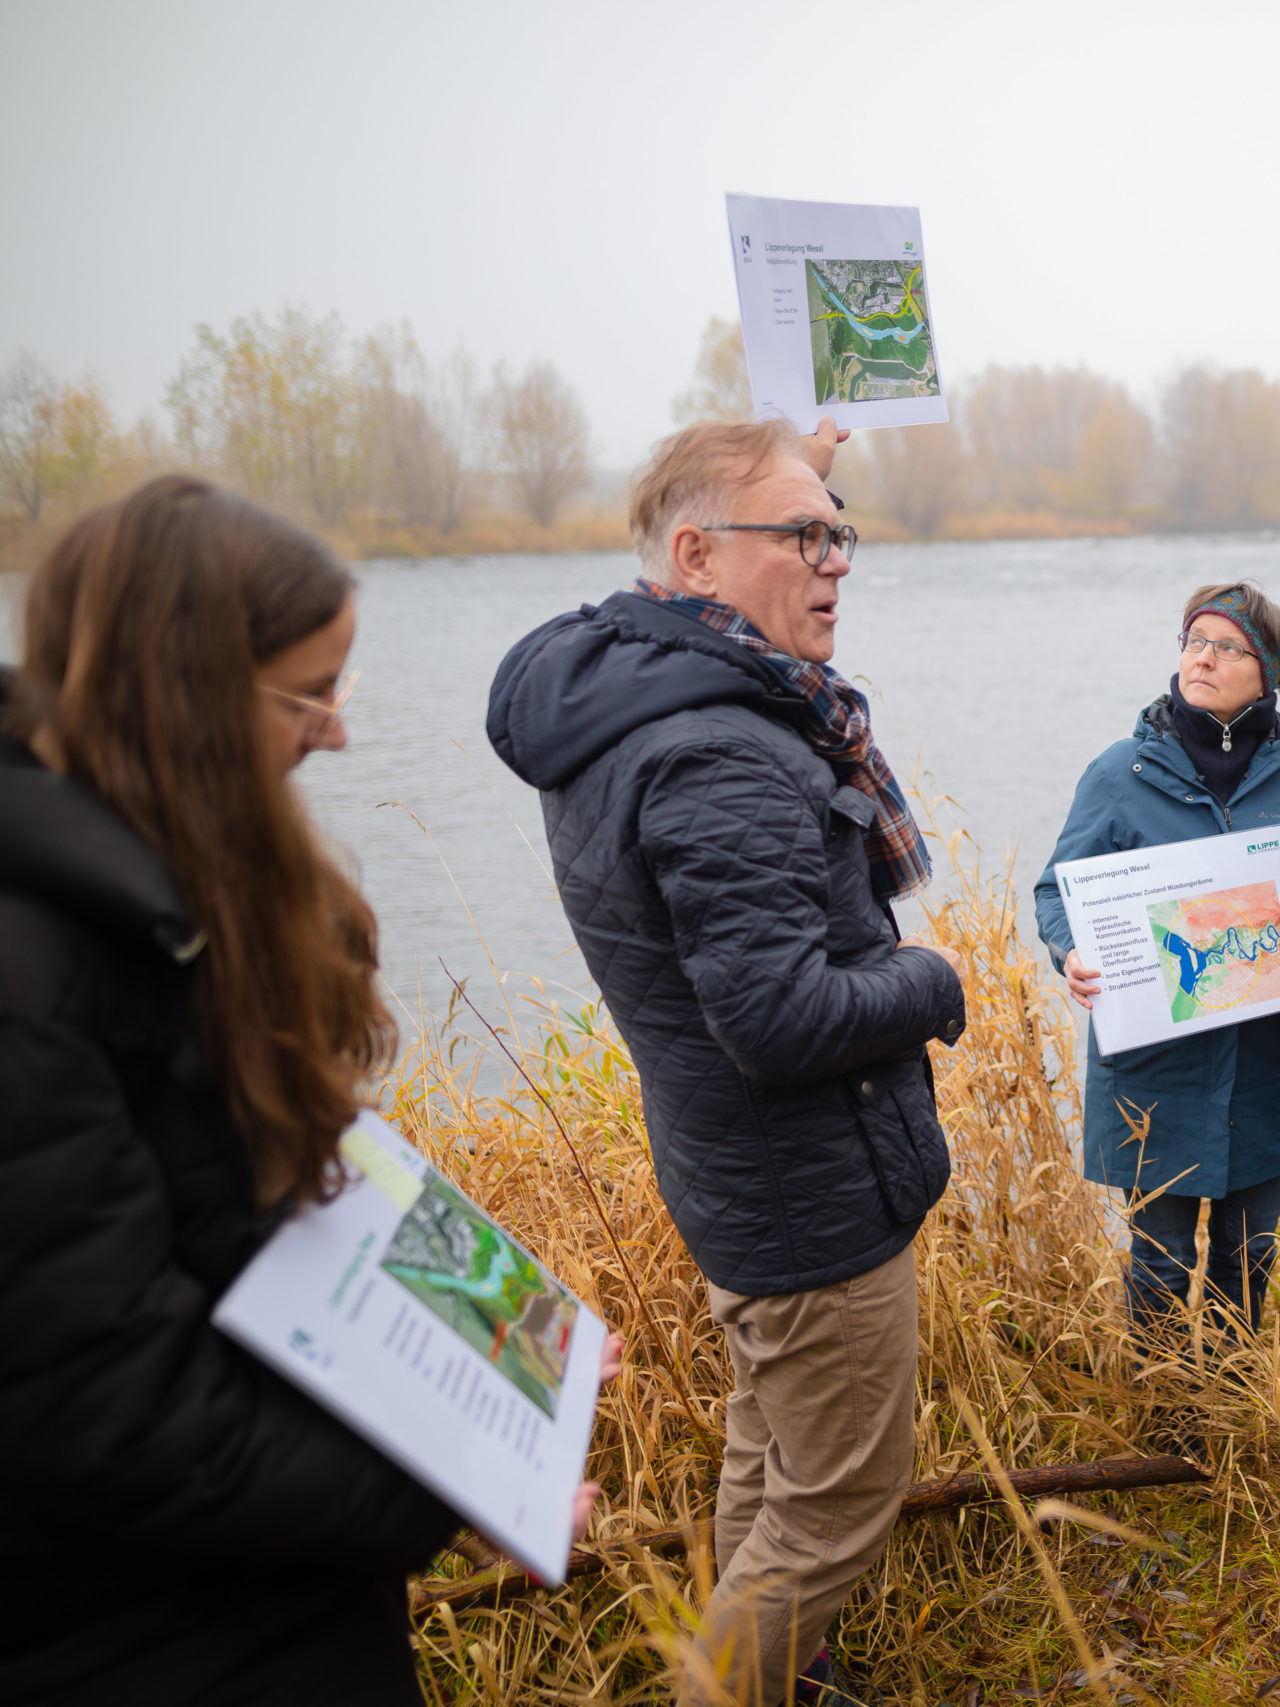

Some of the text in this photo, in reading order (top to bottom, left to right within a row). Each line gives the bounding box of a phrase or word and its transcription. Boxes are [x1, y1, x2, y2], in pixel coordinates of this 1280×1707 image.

[806, 244, 824, 252] Wesel
[1257, 840, 1279, 849] LIPPE
[1073, 863, 1150, 884] Lippeverlegung Wesel
[1082, 897, 1111, 908] Potenziell
[1112, 891, 1143, 902] natürlicher
[1144, 886, 1167, 896] Zustand
[1091, 914, 1119, 924] intensive
[1093, 920, 1131, 932] hydraulische
[1095, 926, 1142, 940] Kommunikation
[1098, 937, 1148, 952] Rückstaueinfluss
[1100, 949, 1130, 960] und lange
[1102, 955, 1144, 968] Überflutungen
[1105, 963, 1161, 980] hohe Eigendynamik
[1108, 976, 1157, 992] Strukturreichtum
